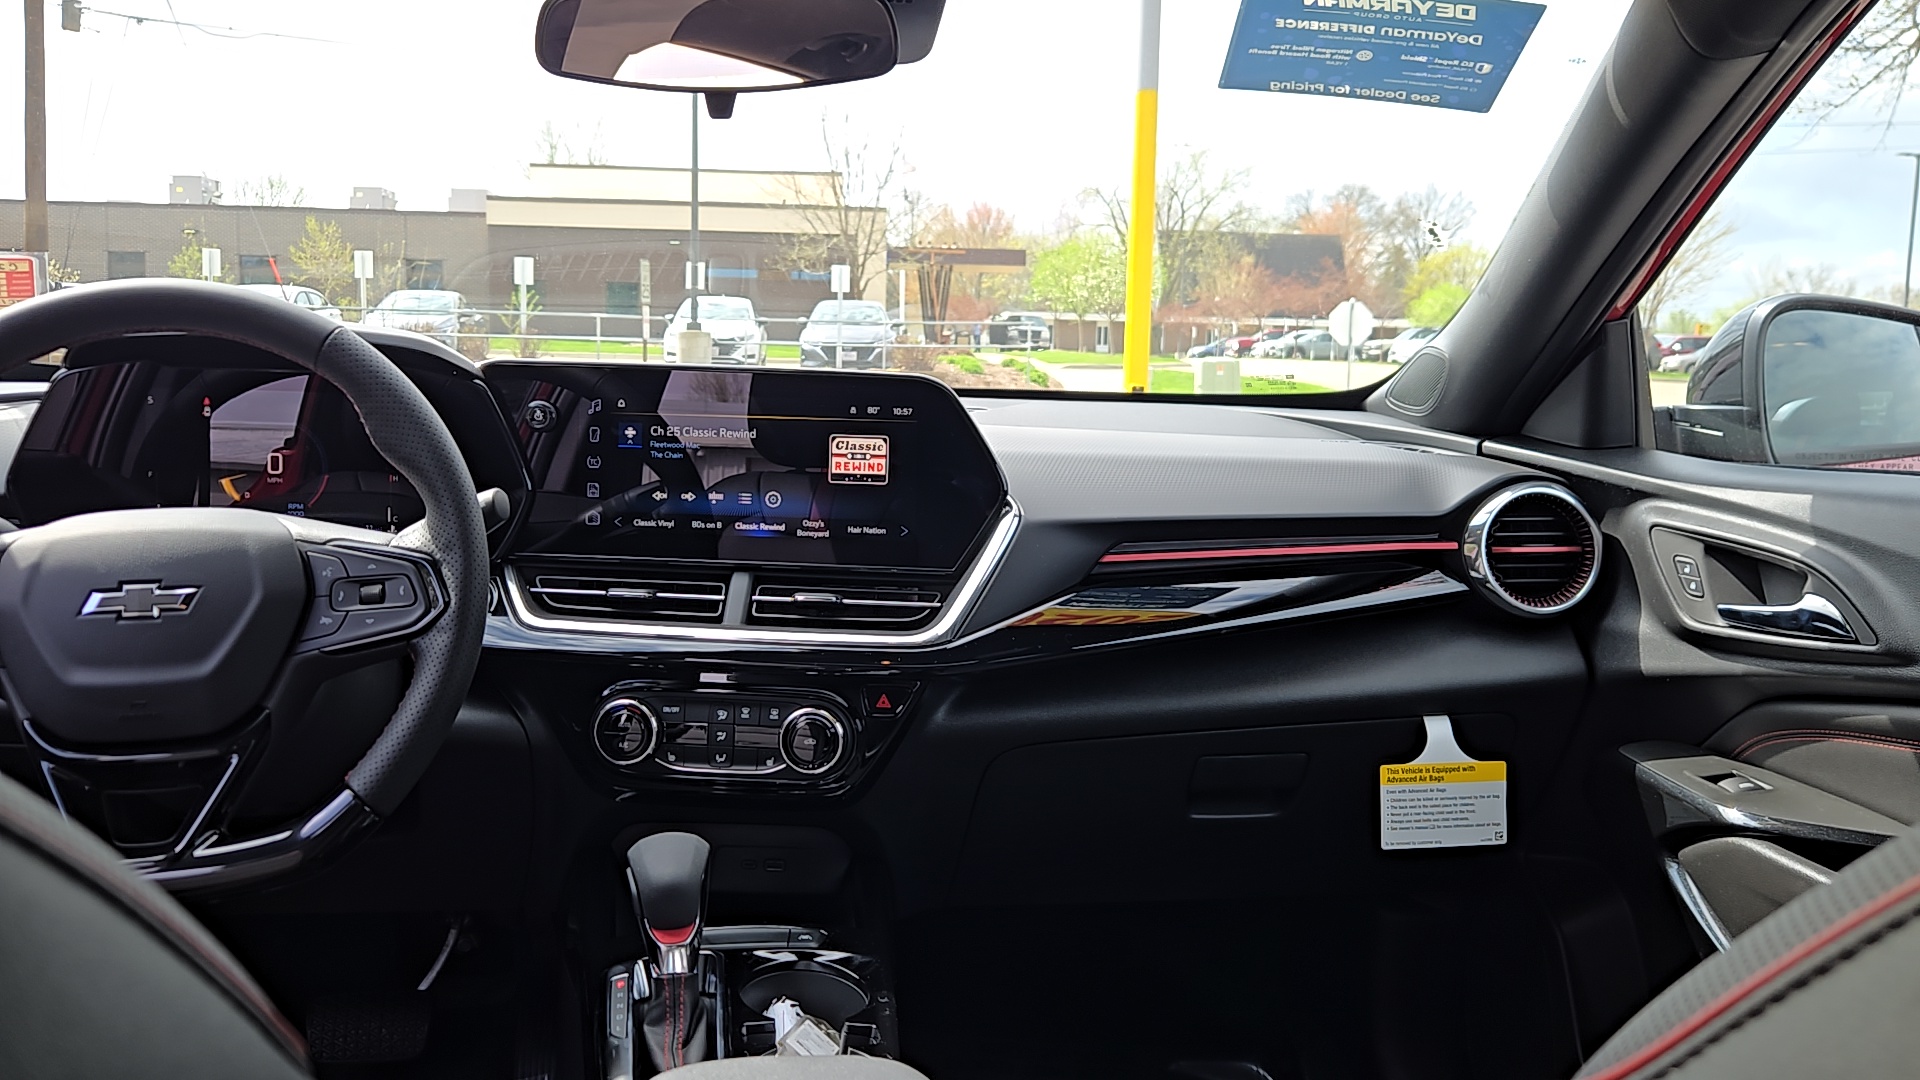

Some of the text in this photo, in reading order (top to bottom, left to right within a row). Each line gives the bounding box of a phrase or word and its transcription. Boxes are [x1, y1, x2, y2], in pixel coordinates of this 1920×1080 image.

[892, 408, 913, 416] 10:57
[650, 426, 757, 439] Ch 25 Classic Rewind
[650, 440, 685, 449] Fleetwood
[836, 440, 884, 452] Classic
[266, 452, 284, 474] 0
[834, 462, 884, 472] REWIND
[633, 519, 674, 528] Classic Vinyl
[734, 522, 786, 531] Classic Rewind
[802, 520, 825, 528] Ozzy's
[796, 529, 830, 538] Boneyard
[847, 526, 886, 534] Hair Nation
[1400, 766, 1424, 774] Vehicle
[1432, 766, 1460, 774] Equipped
[1428, 774, 1445, 782] Bags
